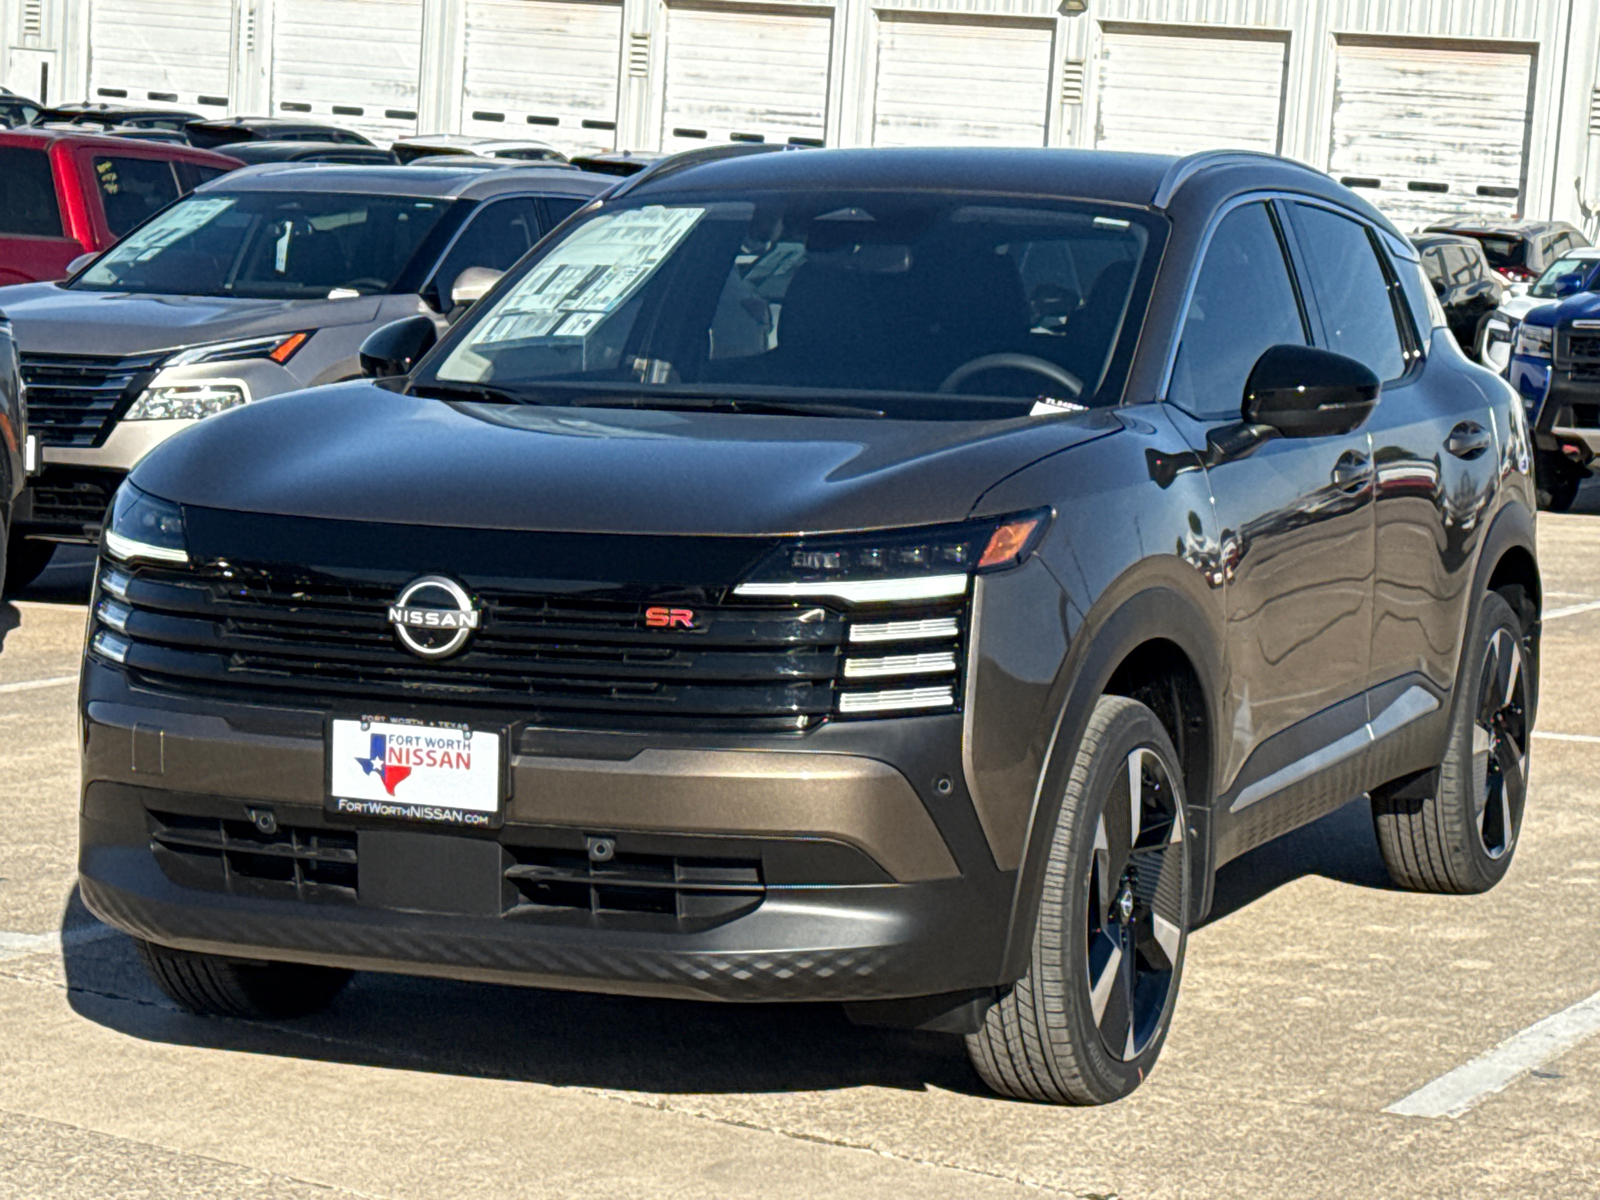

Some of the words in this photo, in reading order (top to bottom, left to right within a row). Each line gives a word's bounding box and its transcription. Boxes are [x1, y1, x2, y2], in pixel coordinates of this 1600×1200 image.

[388, 606, 476, 627] NISSAN
[645, 606, 695, 628] SR
[388, 734, 422, 747] FORT
[424, 736, 471, 751] WORTH
[388, 746, 471, 770] NISSAN
[338, 798, 489, 825] FORTWORTHNISSANCOM
